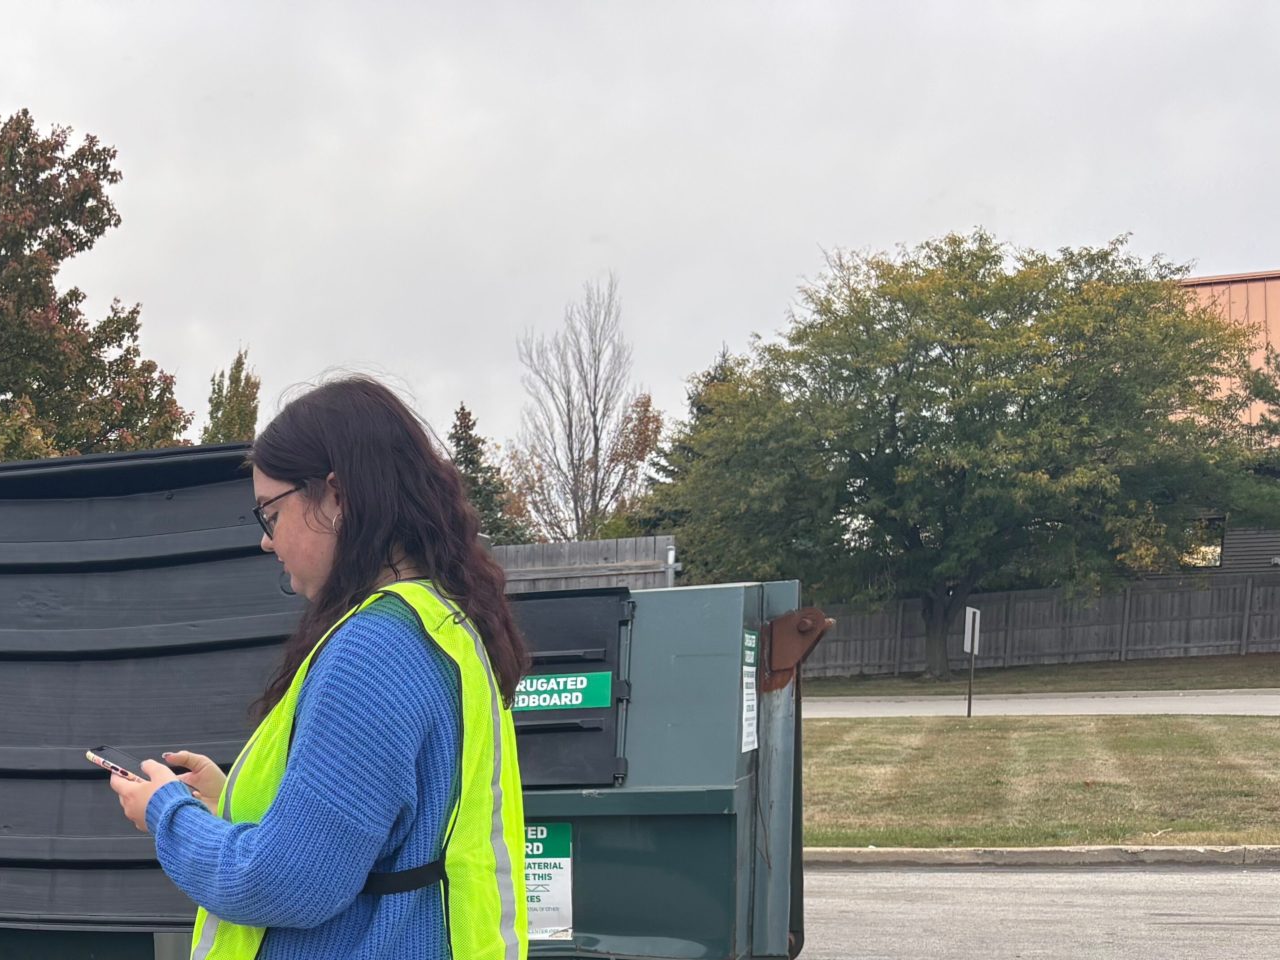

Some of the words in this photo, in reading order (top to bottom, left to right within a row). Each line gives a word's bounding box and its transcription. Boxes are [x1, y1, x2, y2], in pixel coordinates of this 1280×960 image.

[516, 676, 587, 692] RUGATED
[514, 692, 582, 707] DBOARD
[524, 862, 563, 870] ATERIAL
[532, 873, 552, 881] THIS
